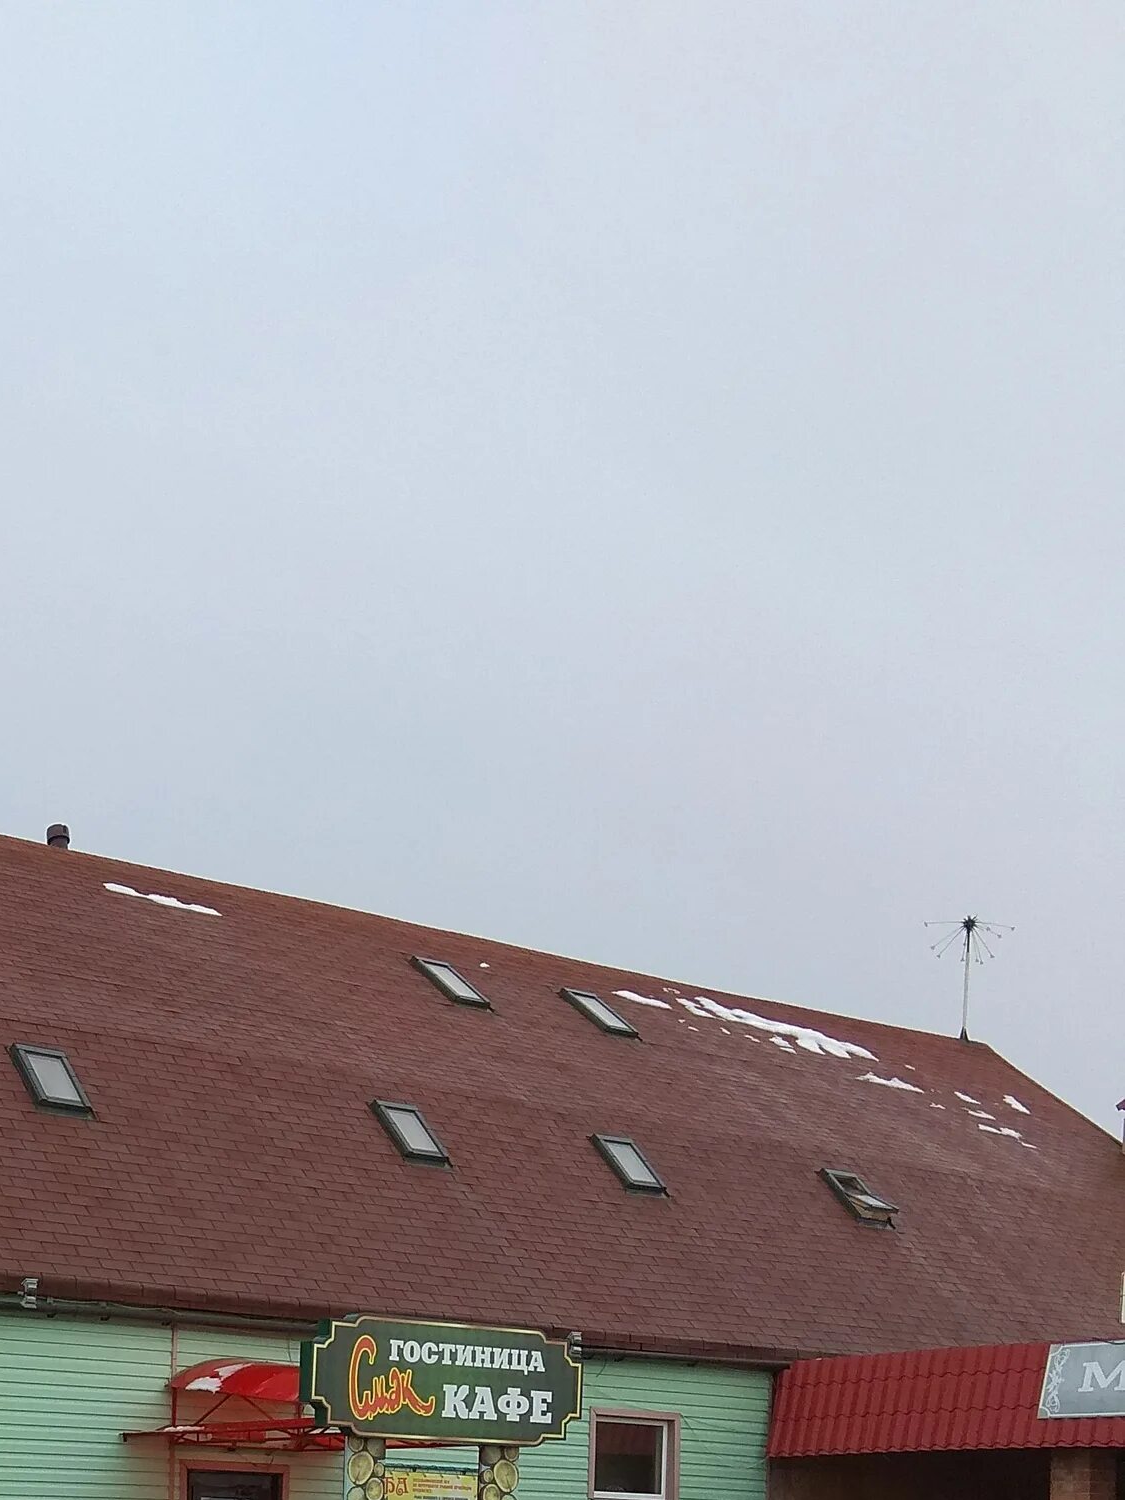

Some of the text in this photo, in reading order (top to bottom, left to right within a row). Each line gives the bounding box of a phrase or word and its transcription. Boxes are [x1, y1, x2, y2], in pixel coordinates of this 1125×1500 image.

[389, 1339, 546, 1375] ГОСТИНИЦА
[349, 1335, 435, 1420] Смак
[441, 1384, 553, 1424] КАФЕ
